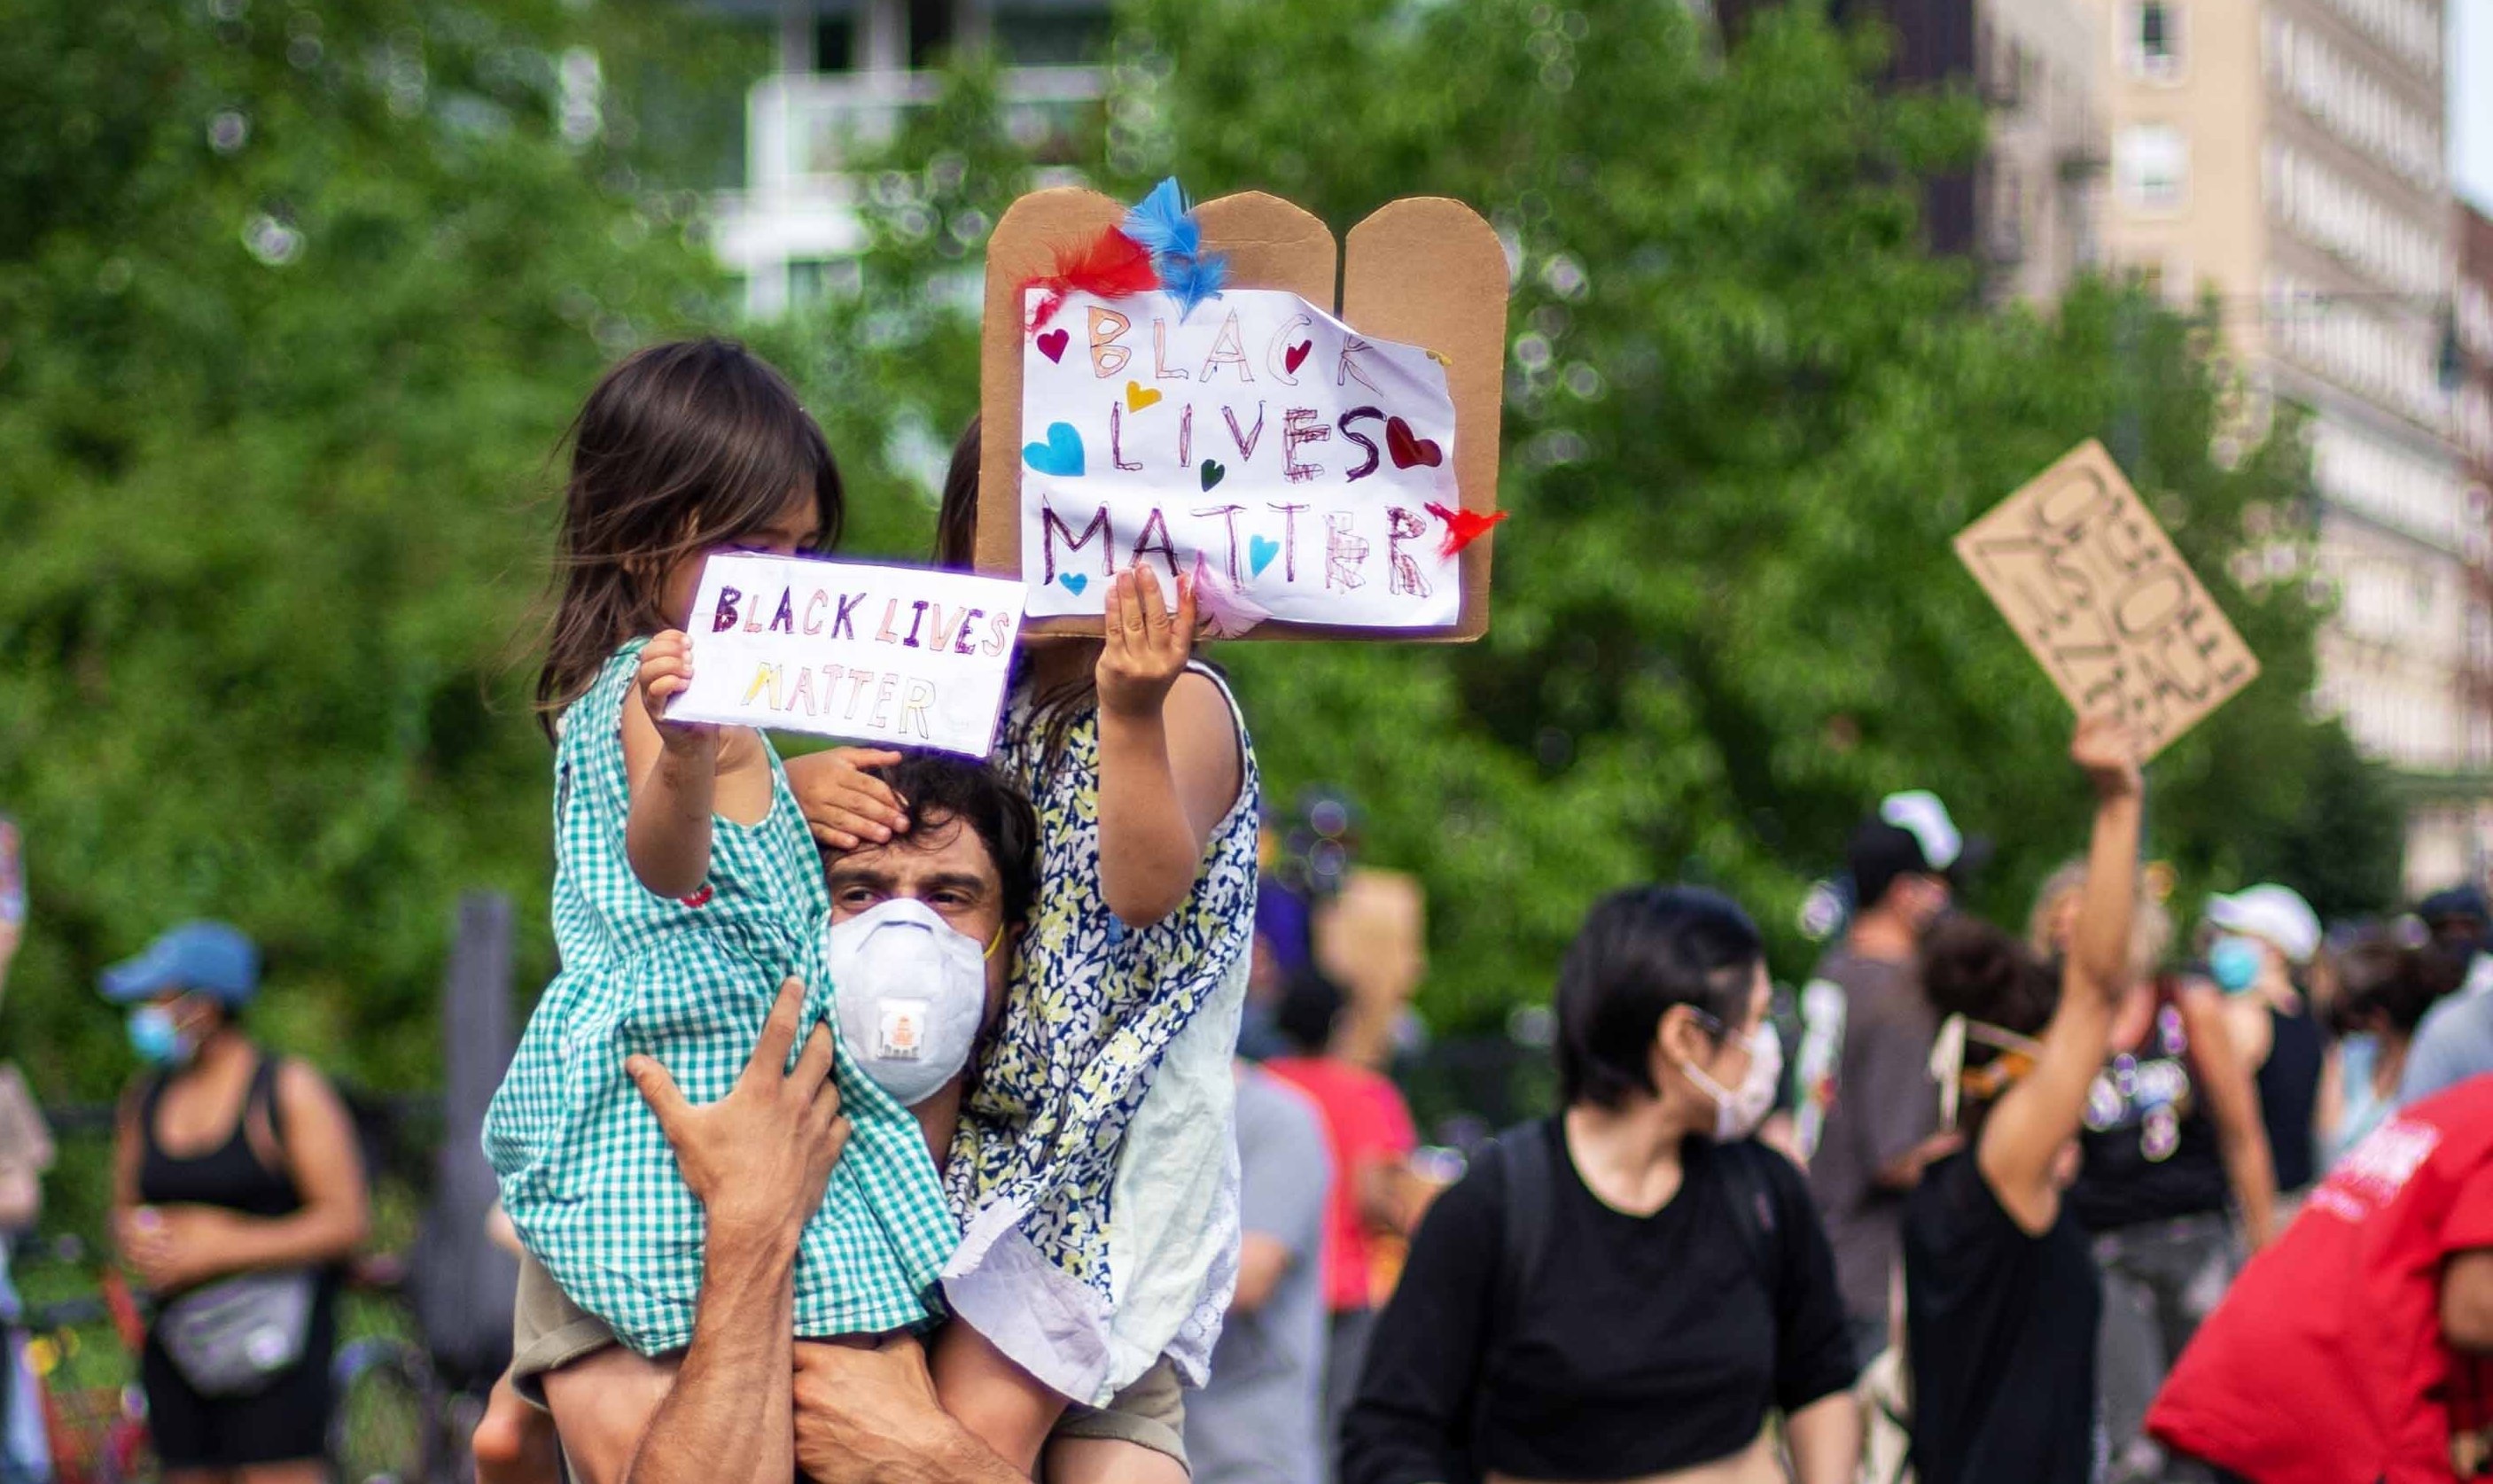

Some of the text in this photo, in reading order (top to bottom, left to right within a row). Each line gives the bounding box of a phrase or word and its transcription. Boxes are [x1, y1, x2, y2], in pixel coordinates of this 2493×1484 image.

[1087, 305, 1384, 397] BLACK
[1110, 400, 1388, 483] LIVES
[1042, 494, 1432, 598] MATTER
[1974, 465, 2106, 581] NO
[713, 585, 1009, 657] BLACK LIVES
[2051, 564, 2188, 686] NO
[740, 662, 936, 739] MATTER
